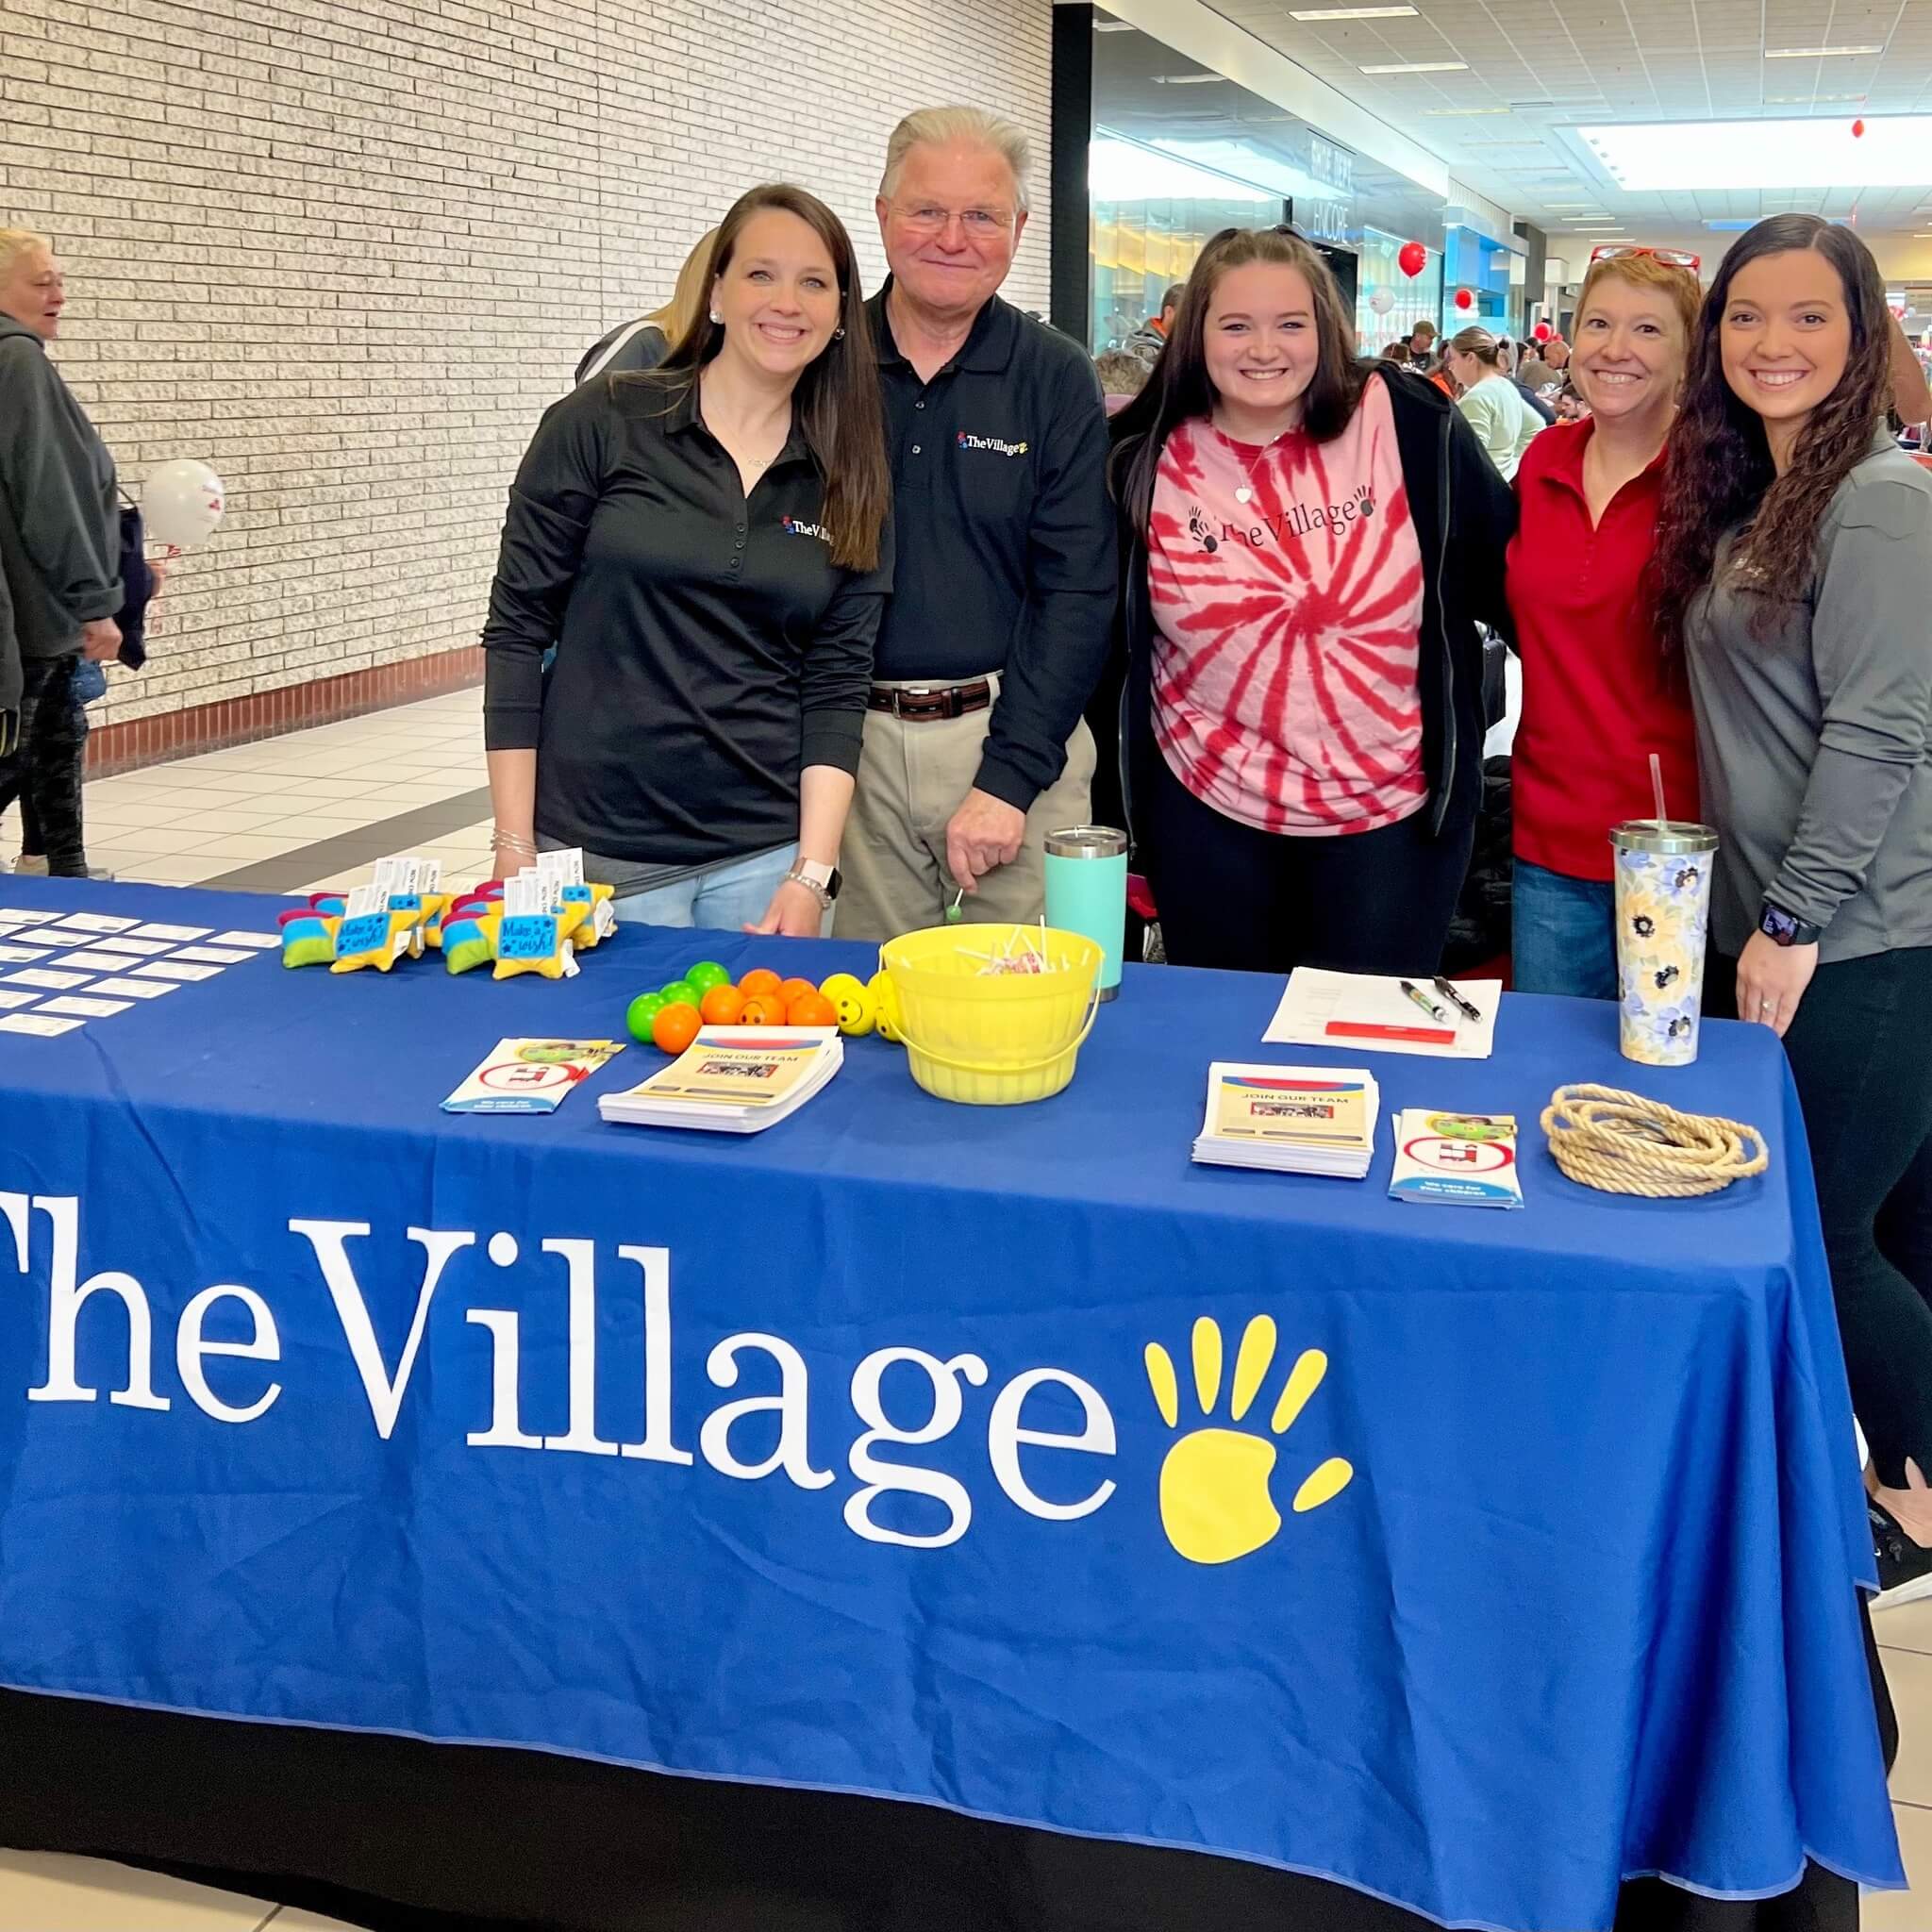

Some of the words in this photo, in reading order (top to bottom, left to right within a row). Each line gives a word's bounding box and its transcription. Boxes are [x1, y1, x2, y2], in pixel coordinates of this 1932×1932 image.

[1241, 1091, 1274, 1101] JOIN
[1277, 1093, 1307, 1102] OUR
[1309, 1095, 1349, 1105] TEAM
